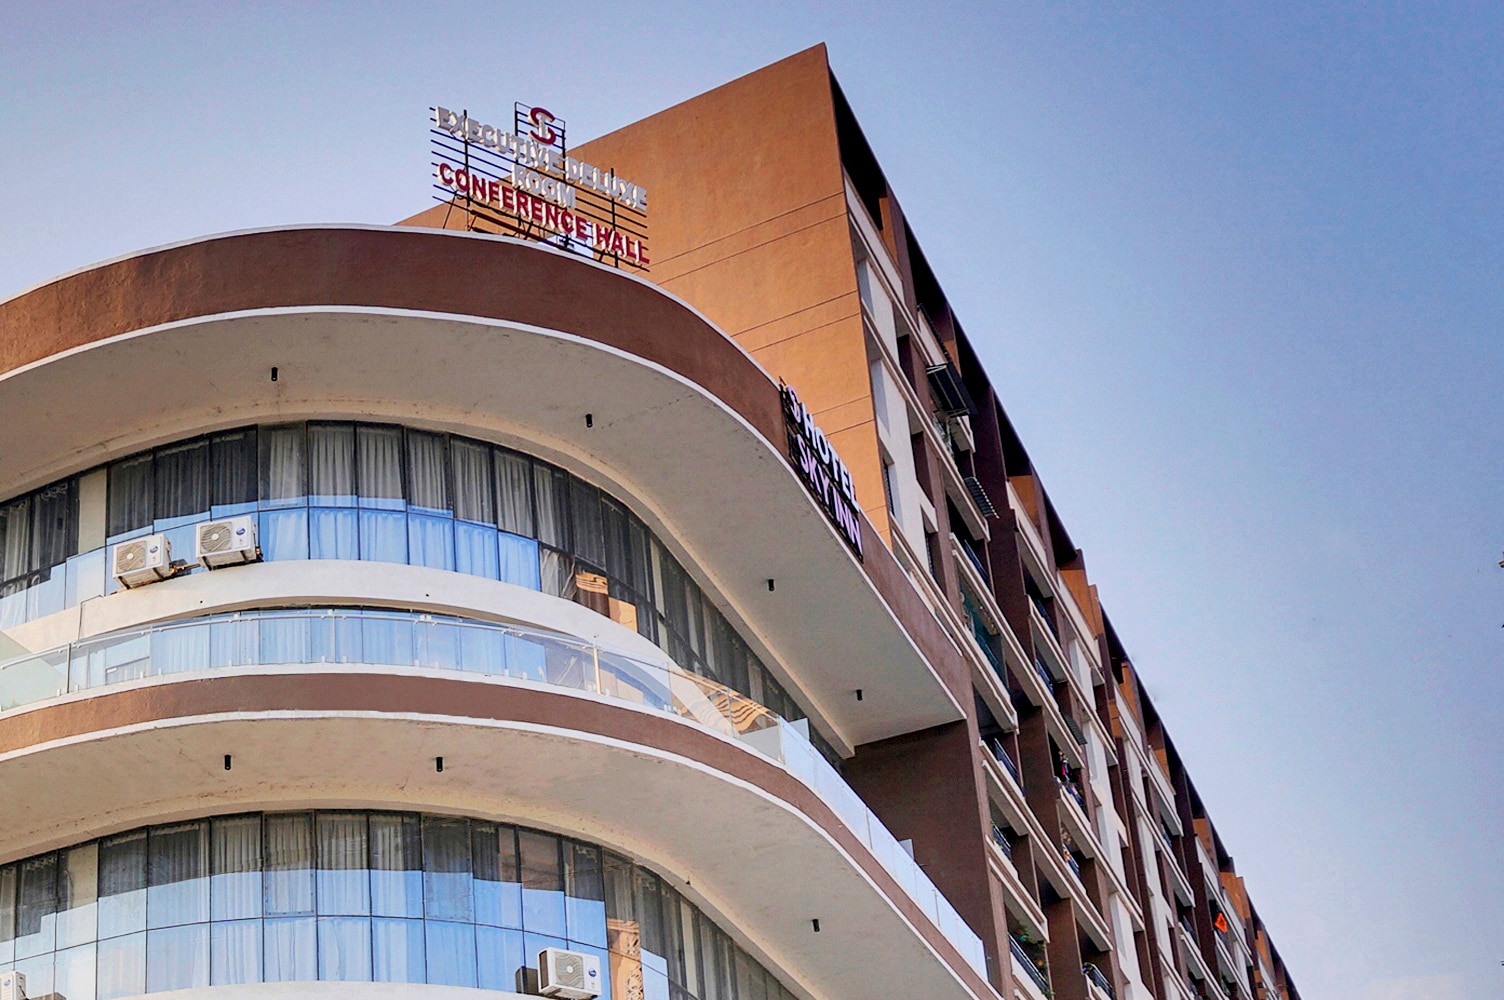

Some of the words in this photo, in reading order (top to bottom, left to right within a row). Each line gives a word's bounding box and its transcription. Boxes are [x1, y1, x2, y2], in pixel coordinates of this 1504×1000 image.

[435, 106, 564, 174] EXECUTIVE
[565, 156, 647, 211] DELUXE
[512, 164, 576, 209] ROOM
[438, 162, 589, 241] CONFERENCE
[593, 223, 650, 264] HALL
[796, 433, 830, 505] SKY
[832, 486, 863, 554] INN
[800, 402, 860, 513] HOTEL
